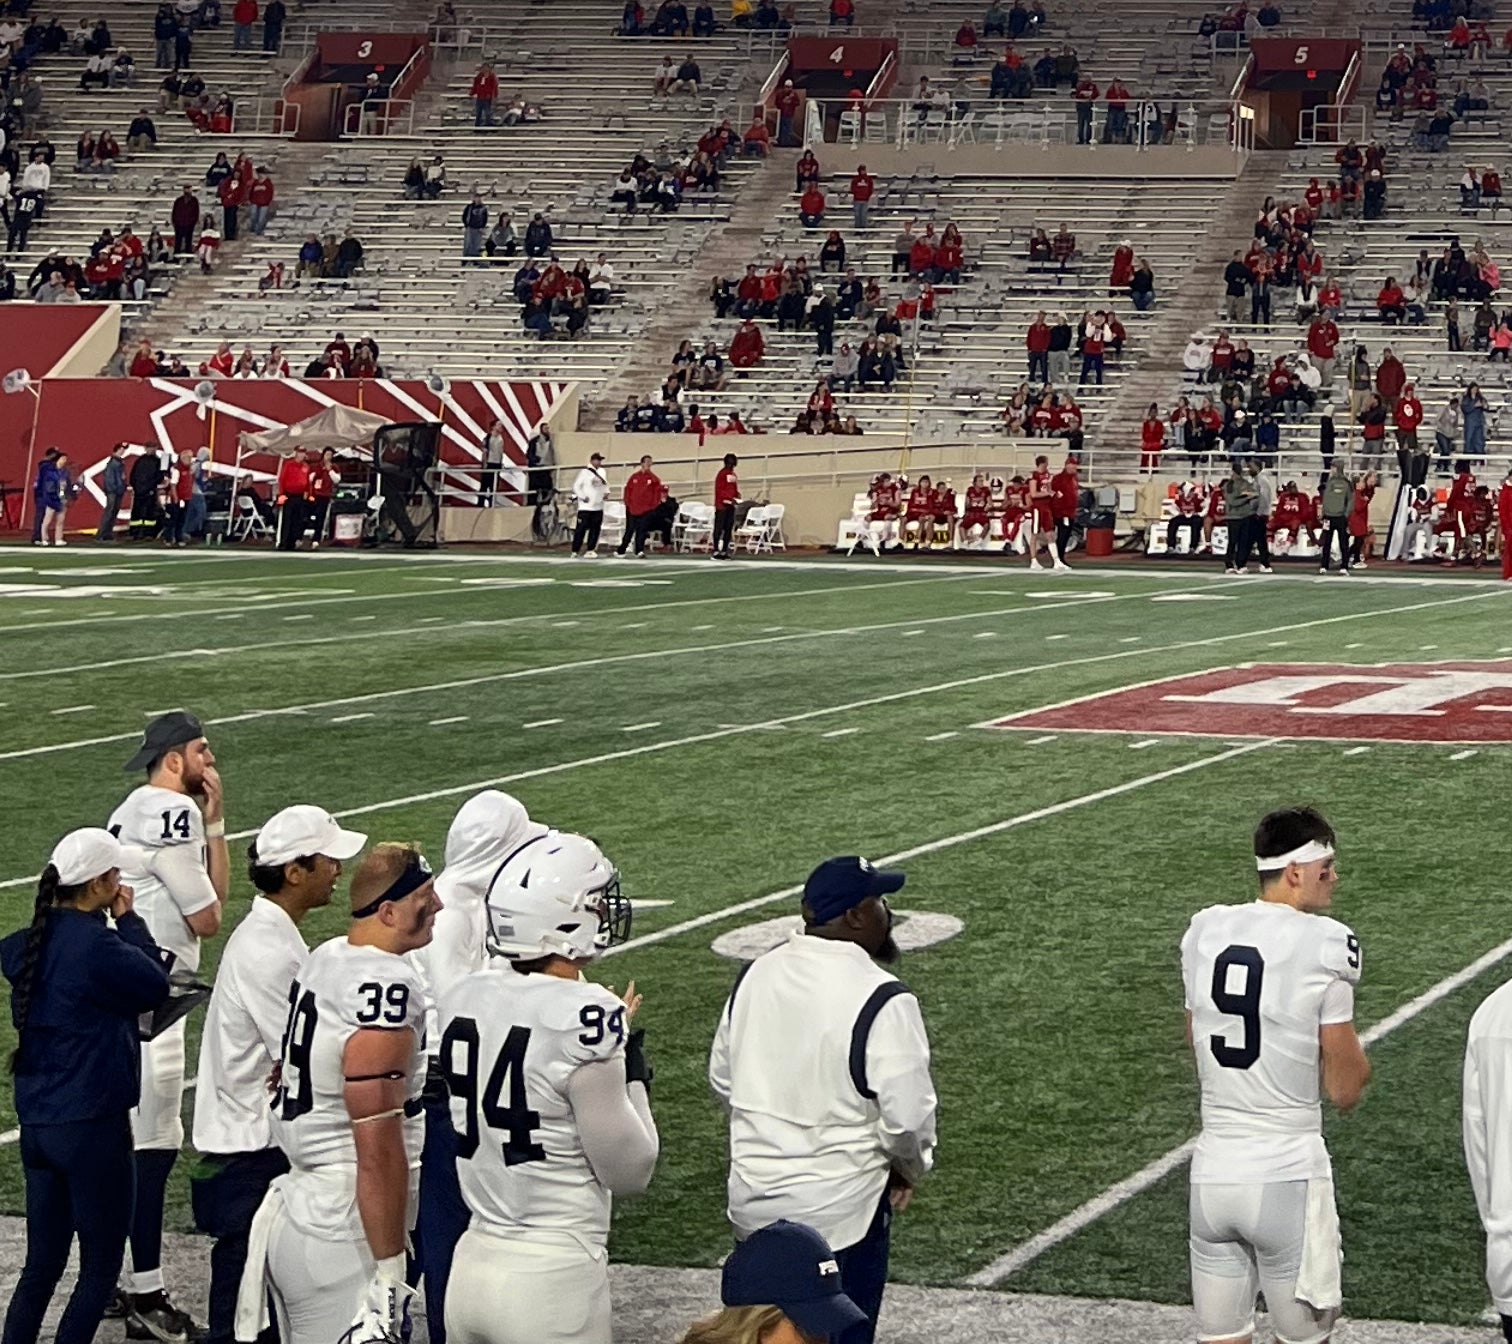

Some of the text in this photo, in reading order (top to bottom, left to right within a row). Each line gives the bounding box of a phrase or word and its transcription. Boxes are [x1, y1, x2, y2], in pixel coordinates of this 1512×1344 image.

[357, 40, 373, 58] 3
[829, 45, 845, 63] 4
[1294, 46, 1309, 64] 5
[161, 810, 191, 838] 14
[356, 982, 410, 1023] 39
[1210, 944, 1265, 1070] 9
[579, 1005, 626, 1047] 94
[439, 1016, 547, 1167] 94
